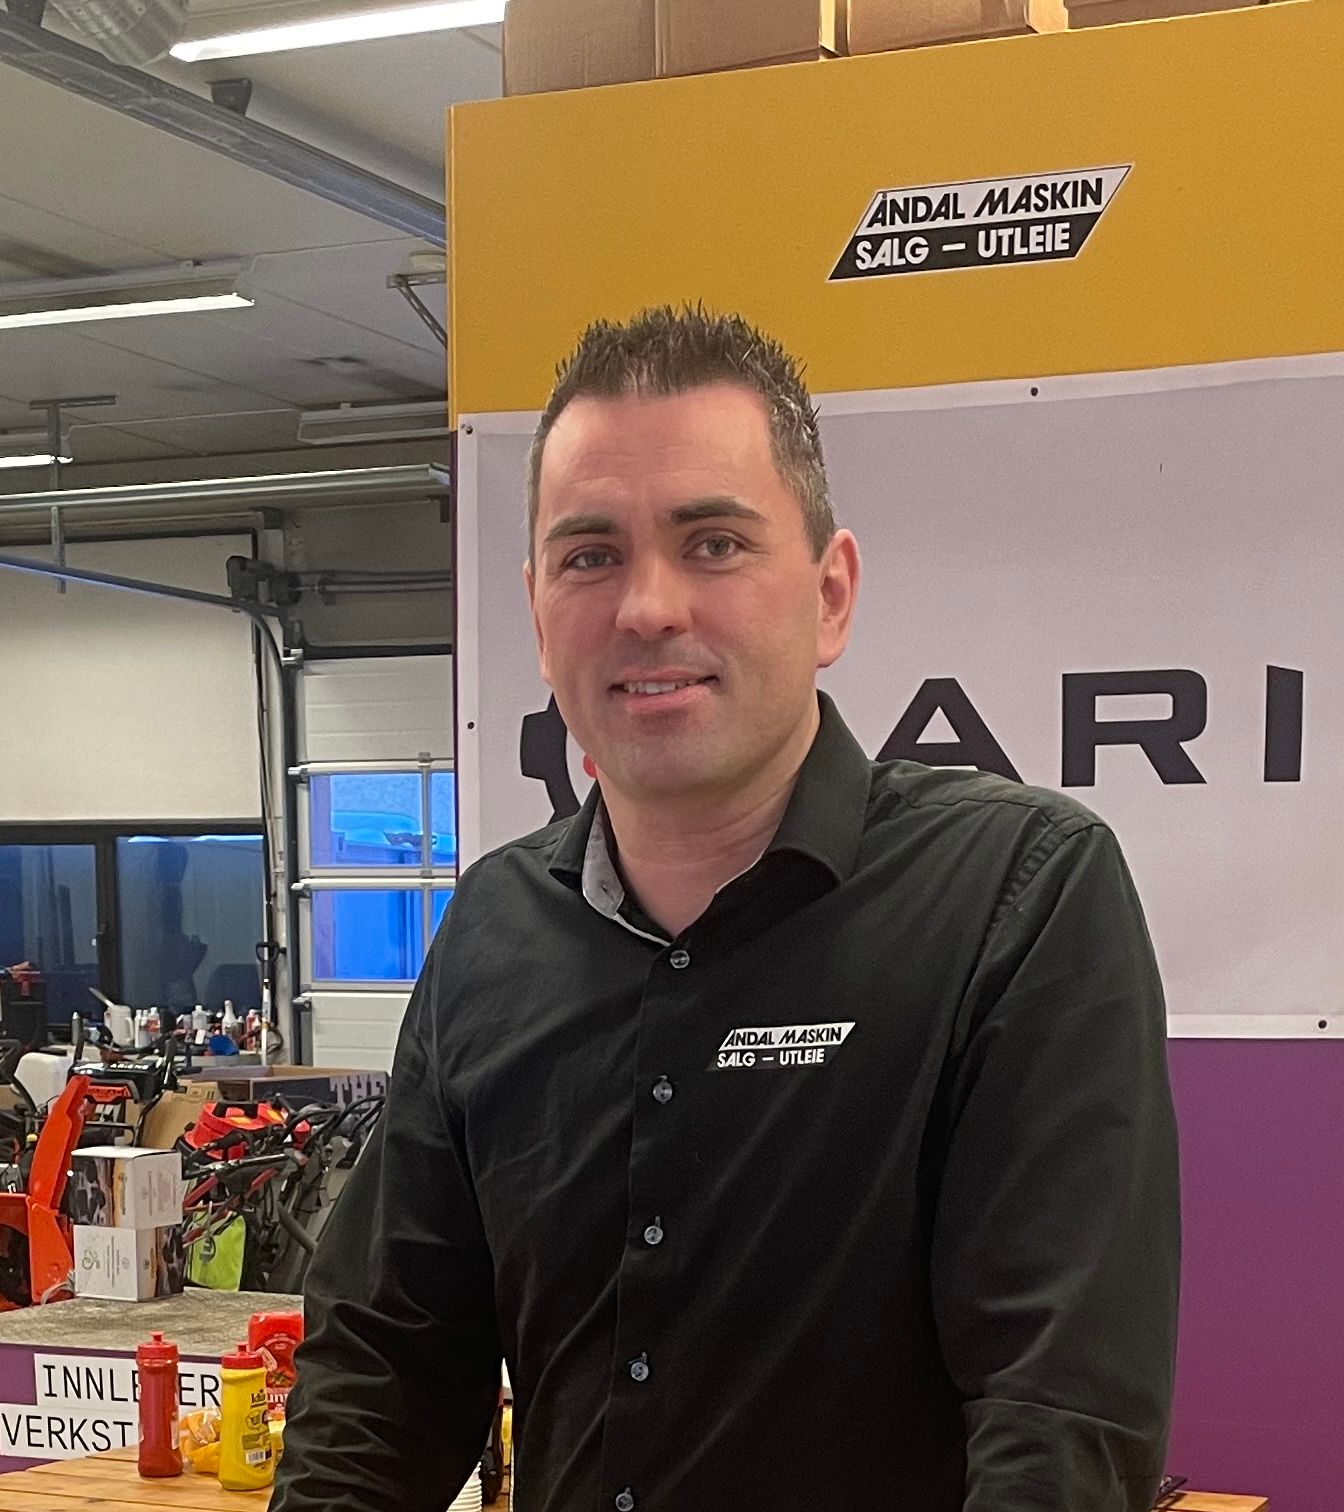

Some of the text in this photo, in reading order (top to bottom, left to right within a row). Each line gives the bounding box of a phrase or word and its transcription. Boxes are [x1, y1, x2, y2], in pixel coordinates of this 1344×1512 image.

[974, 177, 1103, 218] MASKIN
[855, 235, 929, 270] SALG
[977, 222, 1070, 258] UTLEIE
[778, 1027, 842, 1045] MASKIN
[716, 1052, 756, 1068] SALG
[779, 1049, 825, 1065] UTLEIE
[1, 1412, 133, 1452] VERKST
